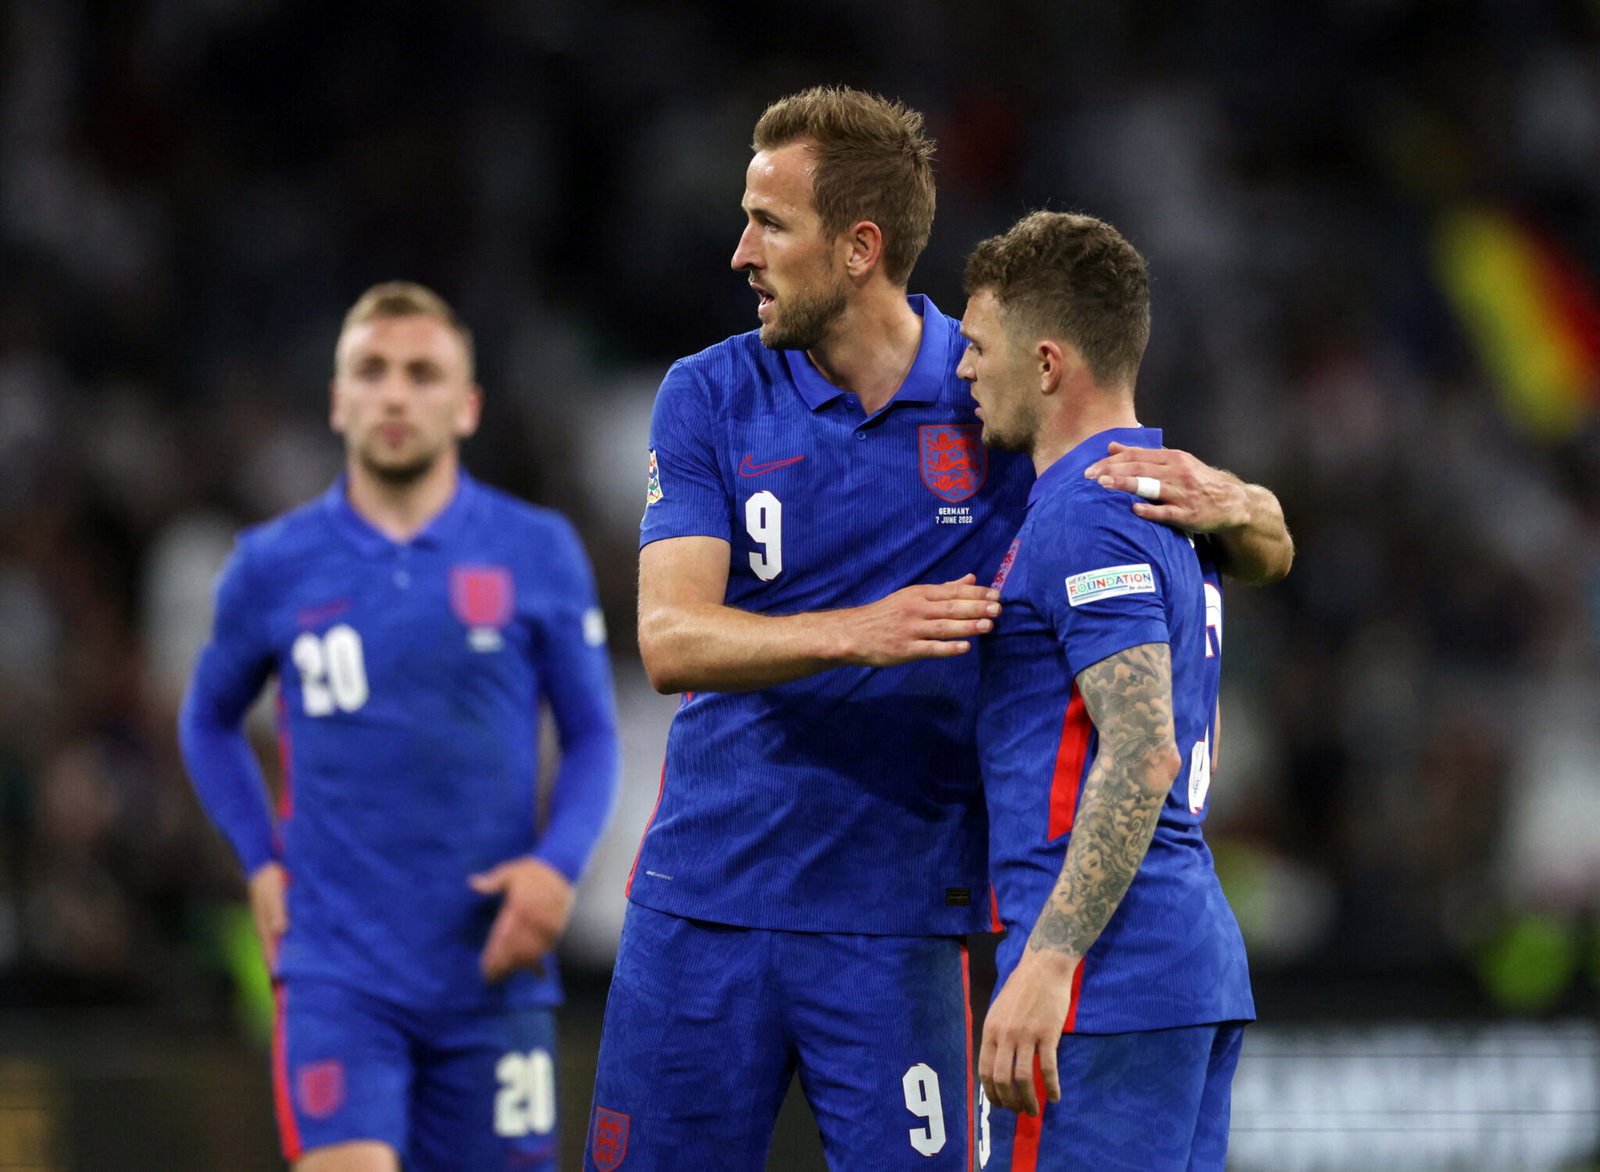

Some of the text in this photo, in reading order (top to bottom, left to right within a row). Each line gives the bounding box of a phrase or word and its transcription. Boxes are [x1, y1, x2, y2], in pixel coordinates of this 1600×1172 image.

[744, 490, 782, 582] 9
[935, 516, 973, 524] 7 JUNE 2022
[938, 507, 970, 515] GERMANY
[292, 623, 370, 718] 20
[493, 1048, 556, 1137] 20
[902, 1062, 947, 1157] 9
